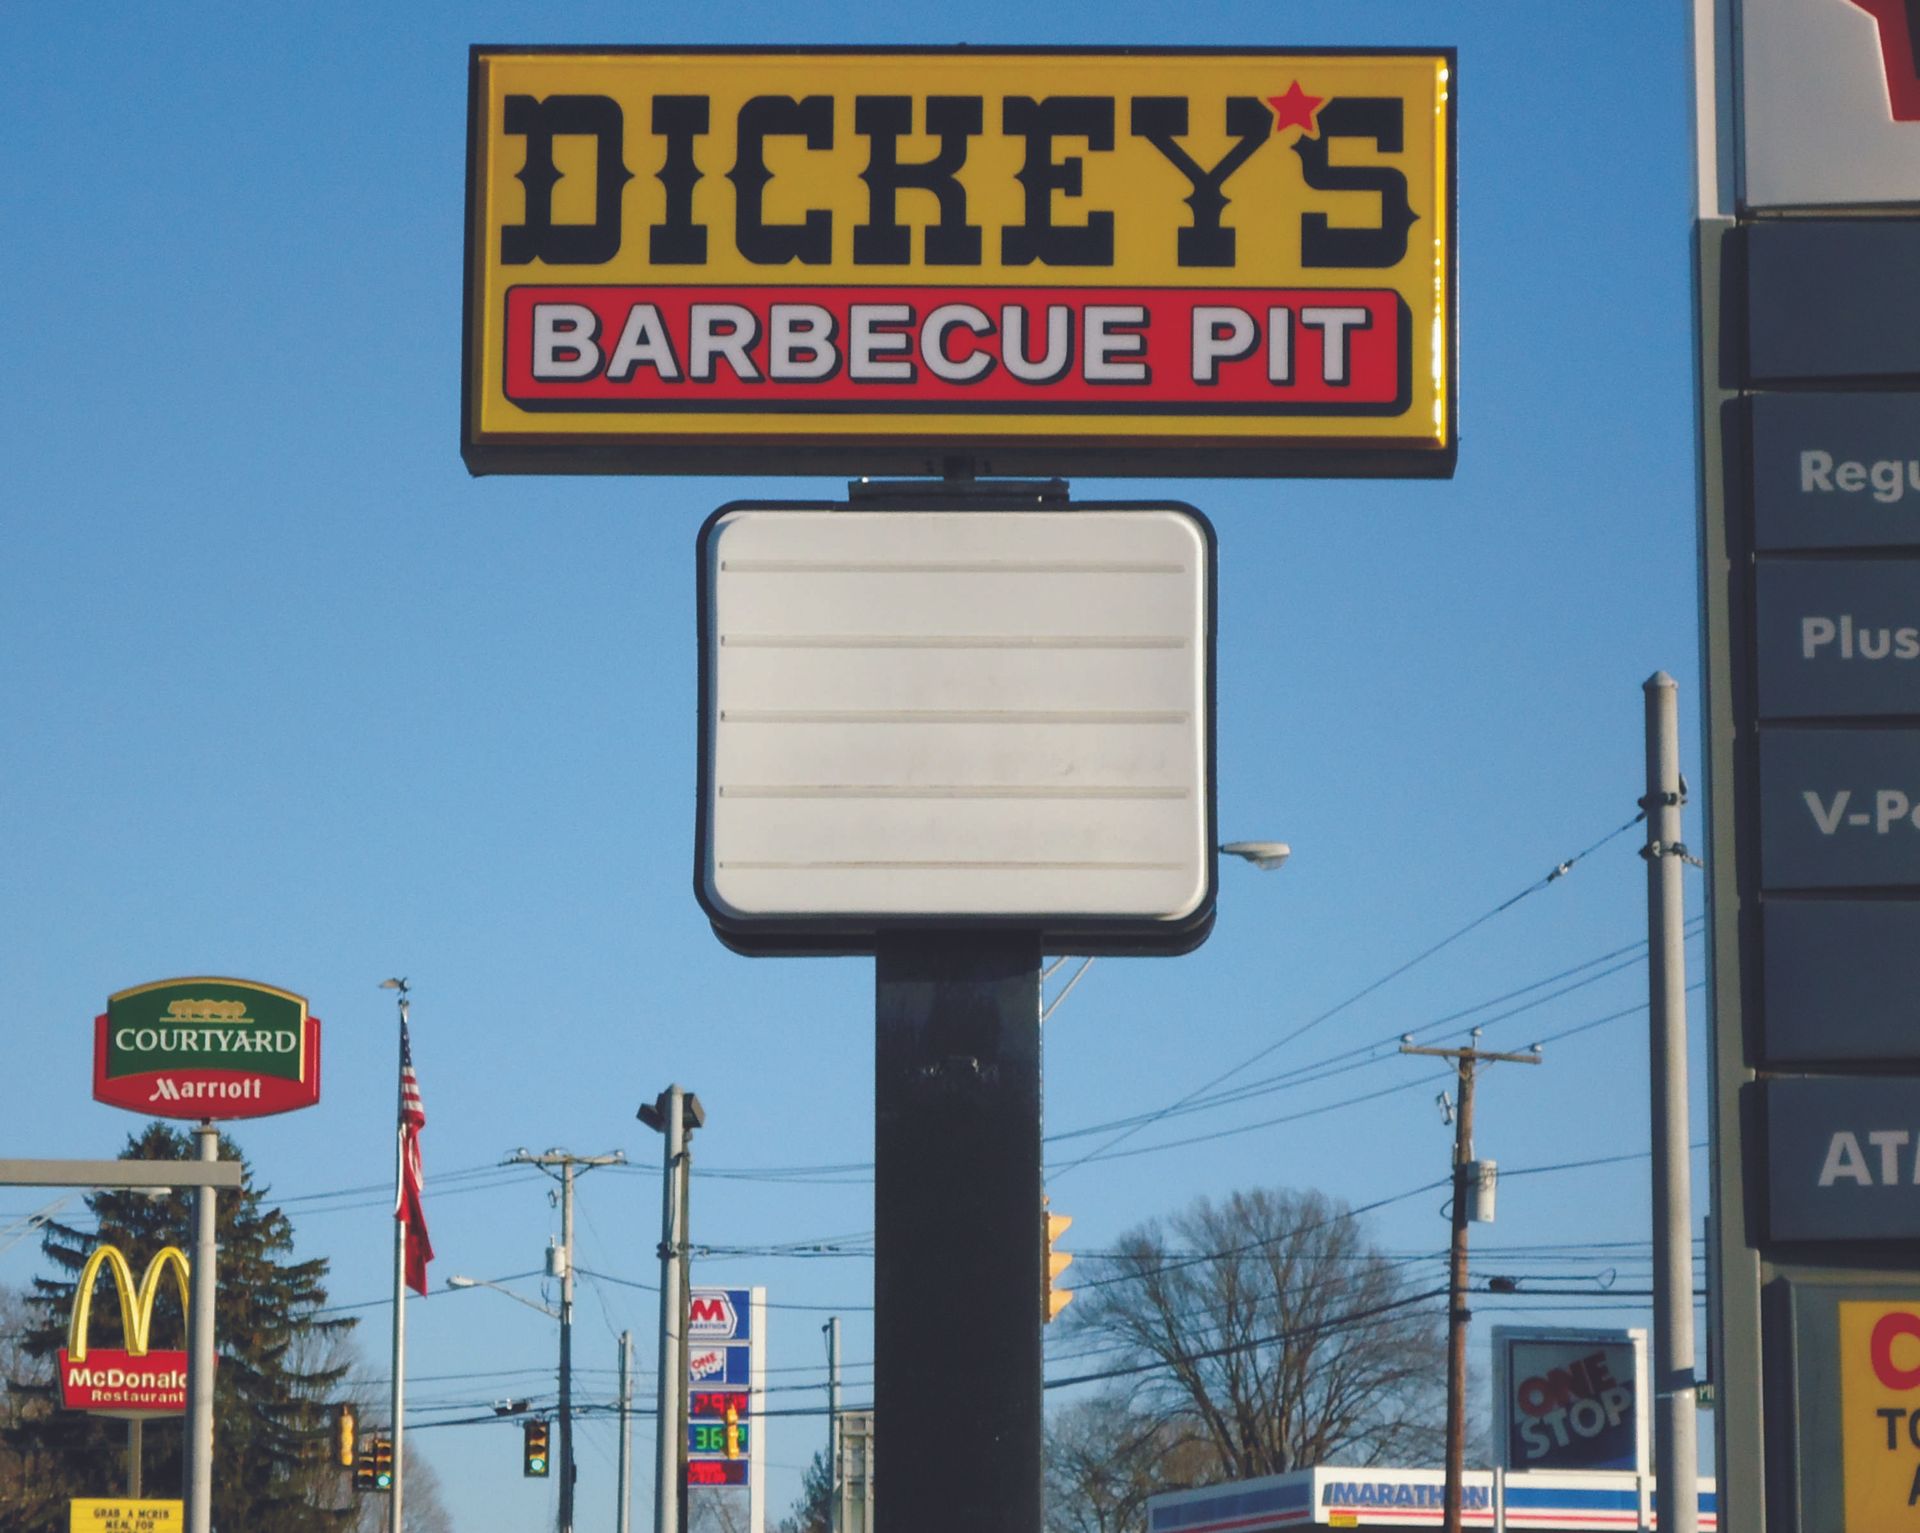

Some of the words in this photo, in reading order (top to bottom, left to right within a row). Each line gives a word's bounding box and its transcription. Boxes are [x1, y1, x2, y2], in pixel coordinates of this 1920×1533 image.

[531, 301, 1151, 385] BARBECUE
[1190, 305, 1371, 388] PIT
[1801, 614, 1920, 660] Plus
[1802, 790, 1920, 835] V-P
[115, 1028, 297, 1053] COURTYARD
[149, 1077, 262, 1101] Marriott
[1817, 1129, 1920, 1187] AT
[91, 1389, 184, 1403] Restaurant
[1518, 1352, 1617, 1418] ONE
[1521, 1386, 1632, 1459] STOP
[94, 1508, 120, 1519] GRAB
[1330, 1482, 1489, 1509] MARATHN
[136, 1520, 154, 1530] FOR
